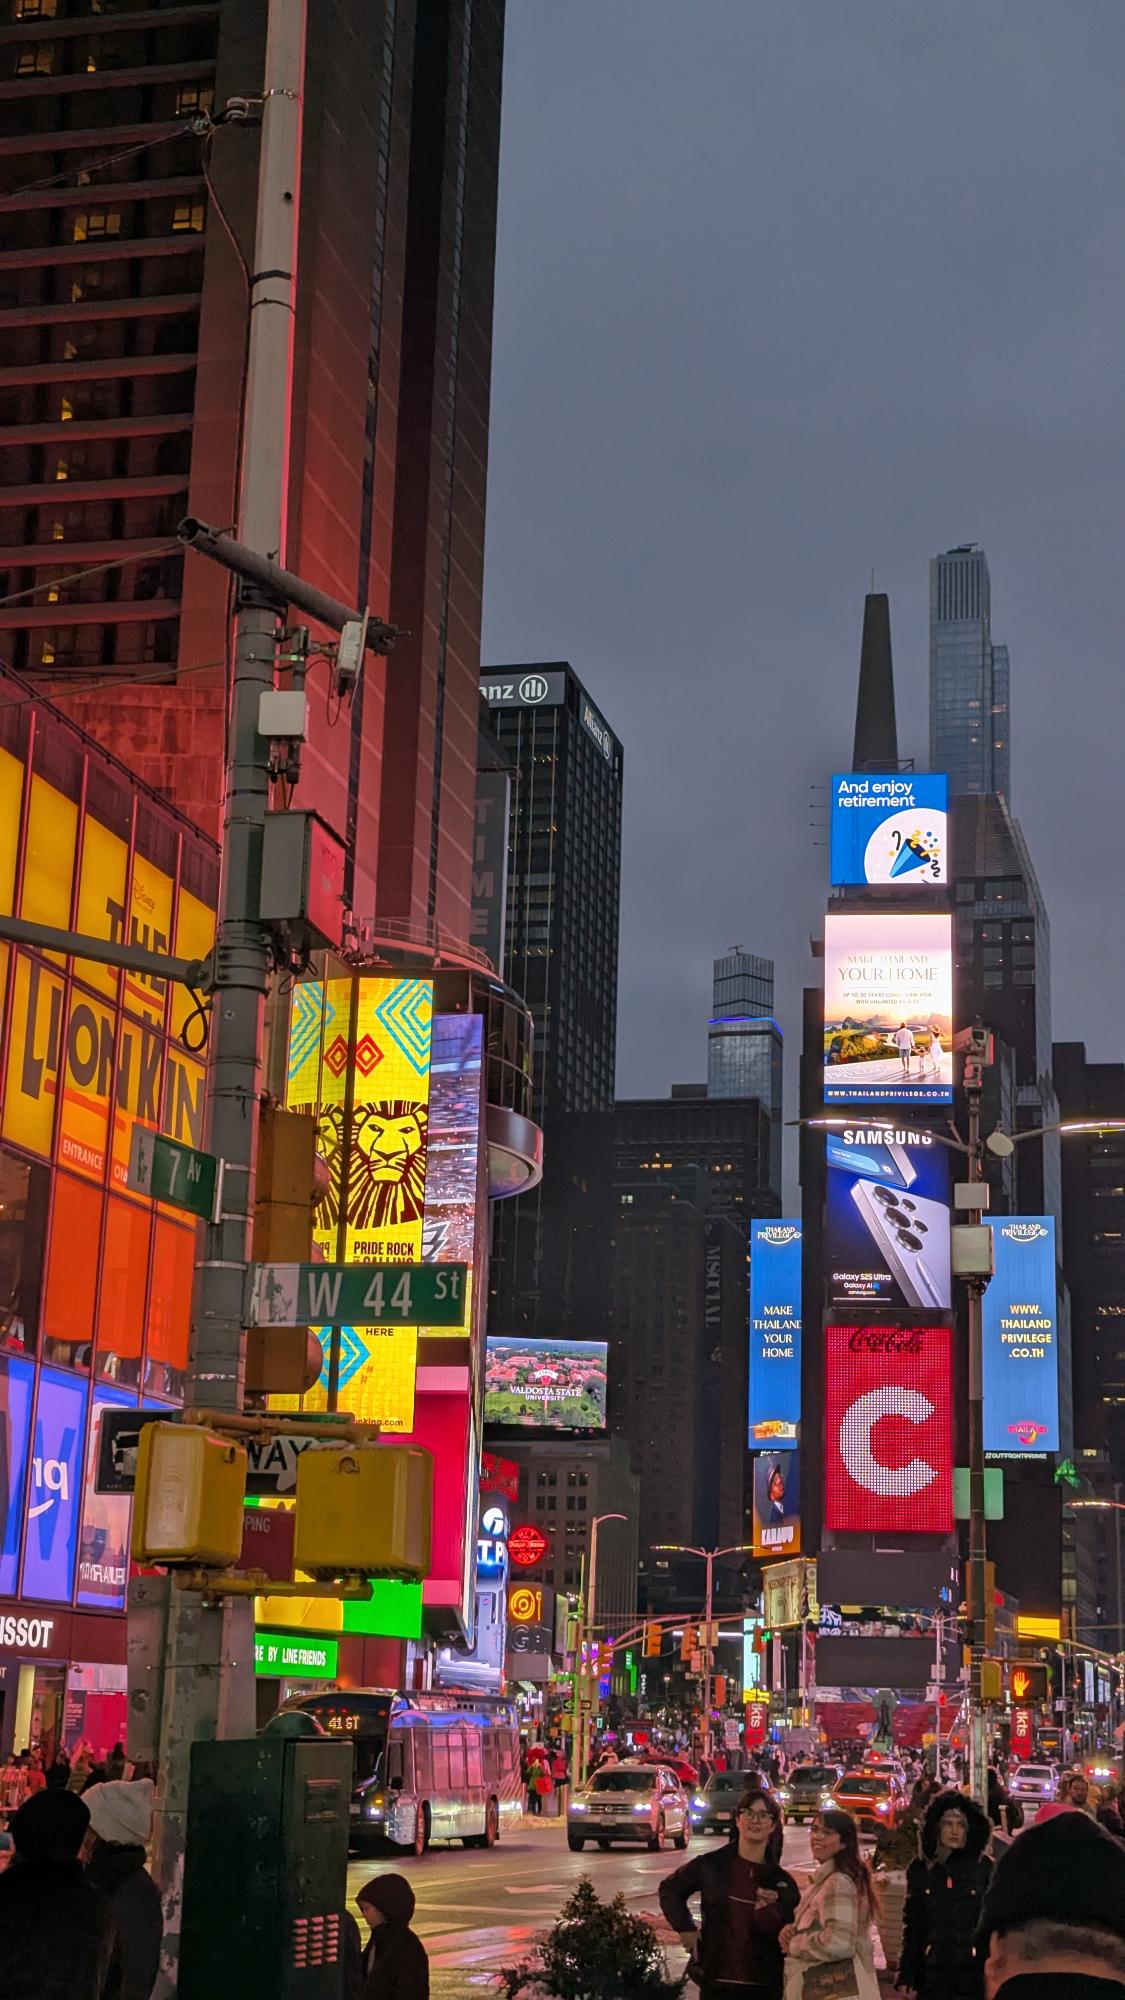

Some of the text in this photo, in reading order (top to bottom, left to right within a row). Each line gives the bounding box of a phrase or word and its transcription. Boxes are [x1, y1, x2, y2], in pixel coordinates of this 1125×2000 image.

[838, 779, 913, 796] And enjoy
[838, 794, 916, 808] retirement
[470, 799, 494, 955] TIME
[838, 967, 939, 981] YOUR HOME
[21, 942, 205, 1149] LION KIN
[843, 1129, 933, 1145] SAMSUNG
[63, 1139, 103, 1170] ENTRANCE
[169, 1149, 203, 1196] 7 Av
[354, 1241, 415, 1256] PRIDE ROCK
[832, 1272, 892, 1282] Galaxy S25 Ultra
[843, 1282, 866, 1290] Galaxy
[308, 1270, 460, 1318] W 44 St
[763, 1305, 793, 1315] MAKE
[1009, 1304, 1042, 1315] WWW.
[1000, 1319, 1052, 1329] THAILAND
[365, 1328, 395, 1337] HERE
[763, 1333, 793, 1344] YOUR
[1001, 1333, 1052, 1343] PRIVILEGE
[762, 1347, 794, 1358] HOME
[1009, 1347, 1045, 1358] .CO.TH
[509, 1384, 582, 1397] VALDOSTA STATE
[840, 1386, 938, 1497] C
[243, 1517, 270, 1534] PING
[268, 1646, 278, 1662] BY
[750, 1703, 763, 1728] tkts
[328, 1716, 343, 1730] 41
[1016, 1710, 1029, 1738] tkts
